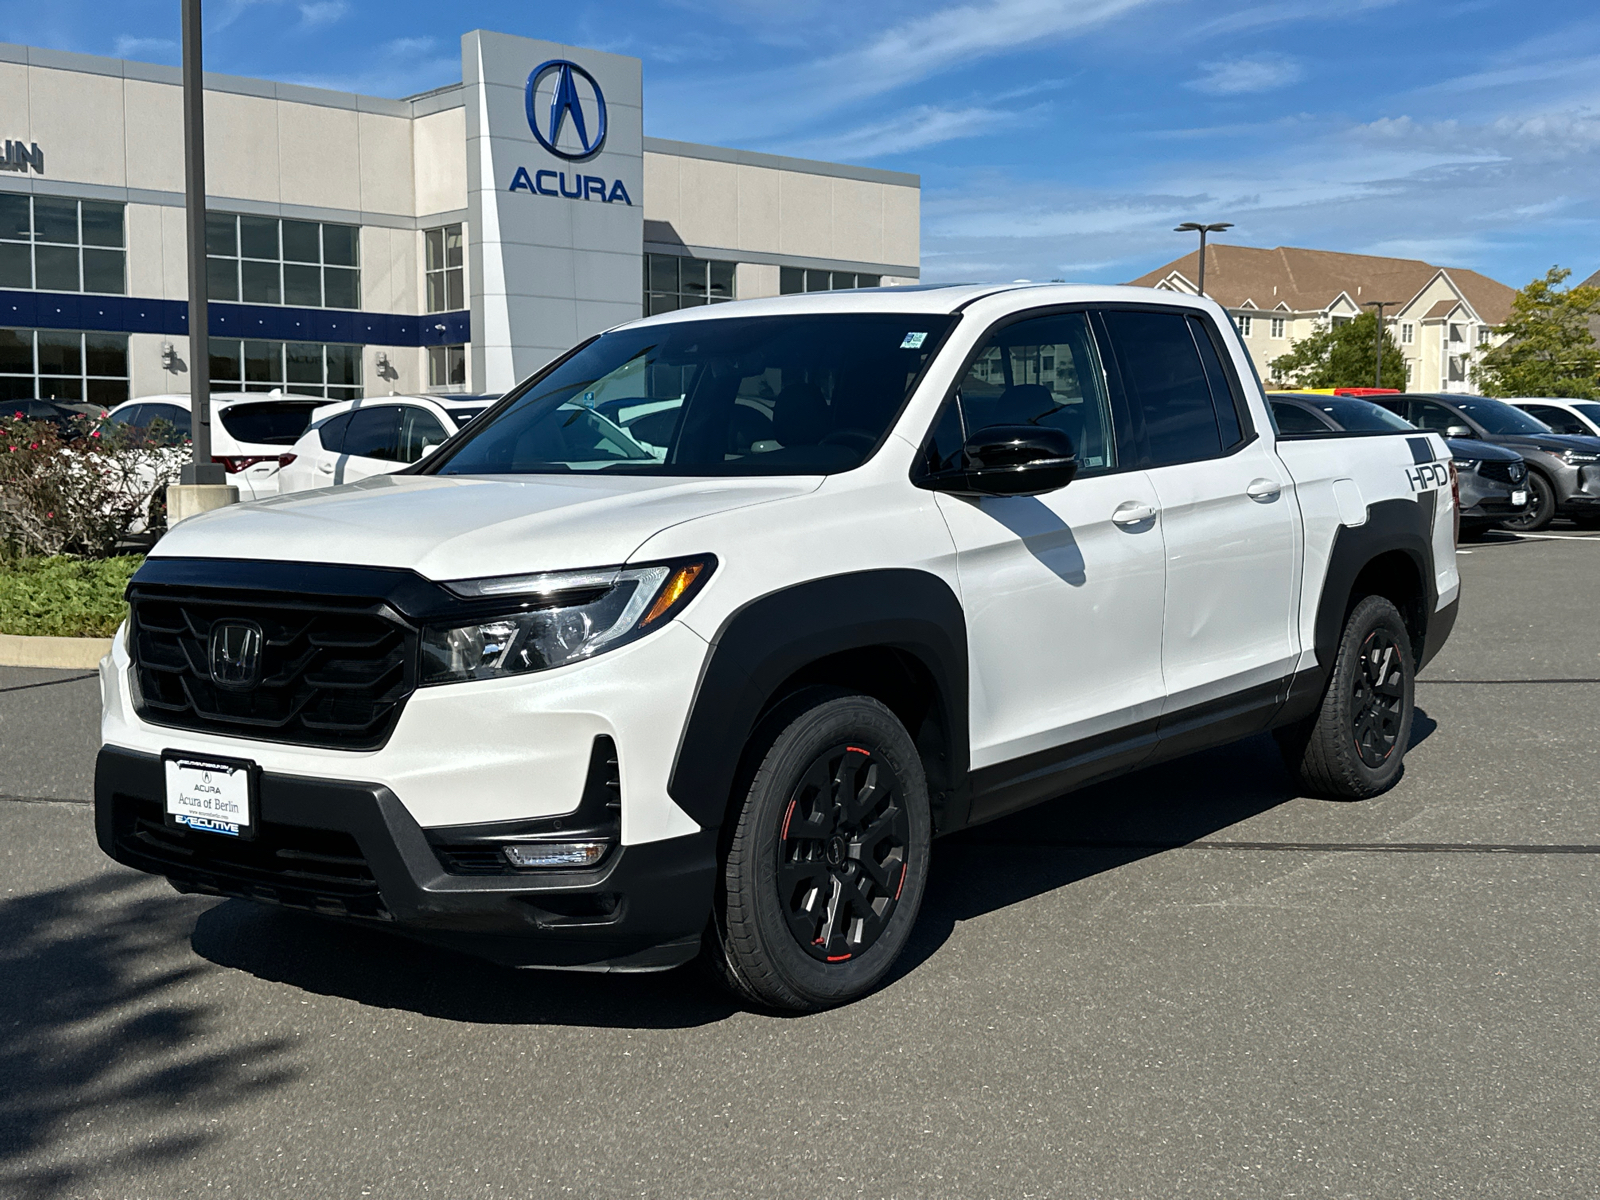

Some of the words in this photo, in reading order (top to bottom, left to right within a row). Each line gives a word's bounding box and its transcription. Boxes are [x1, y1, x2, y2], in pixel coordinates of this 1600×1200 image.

[0, 139, 44, 175] IN
[508, 166, 632, 206] ACURA
[1404, 463, 1448, 492] HPD
[193, 783, 221, 795] ACURA
[178, 792, 202, 807] Acura
[203, 798, 212, 809] of
[214, 799, 239, 814] Berlin
[175, 814, 239, 832] EXECUTIVE
